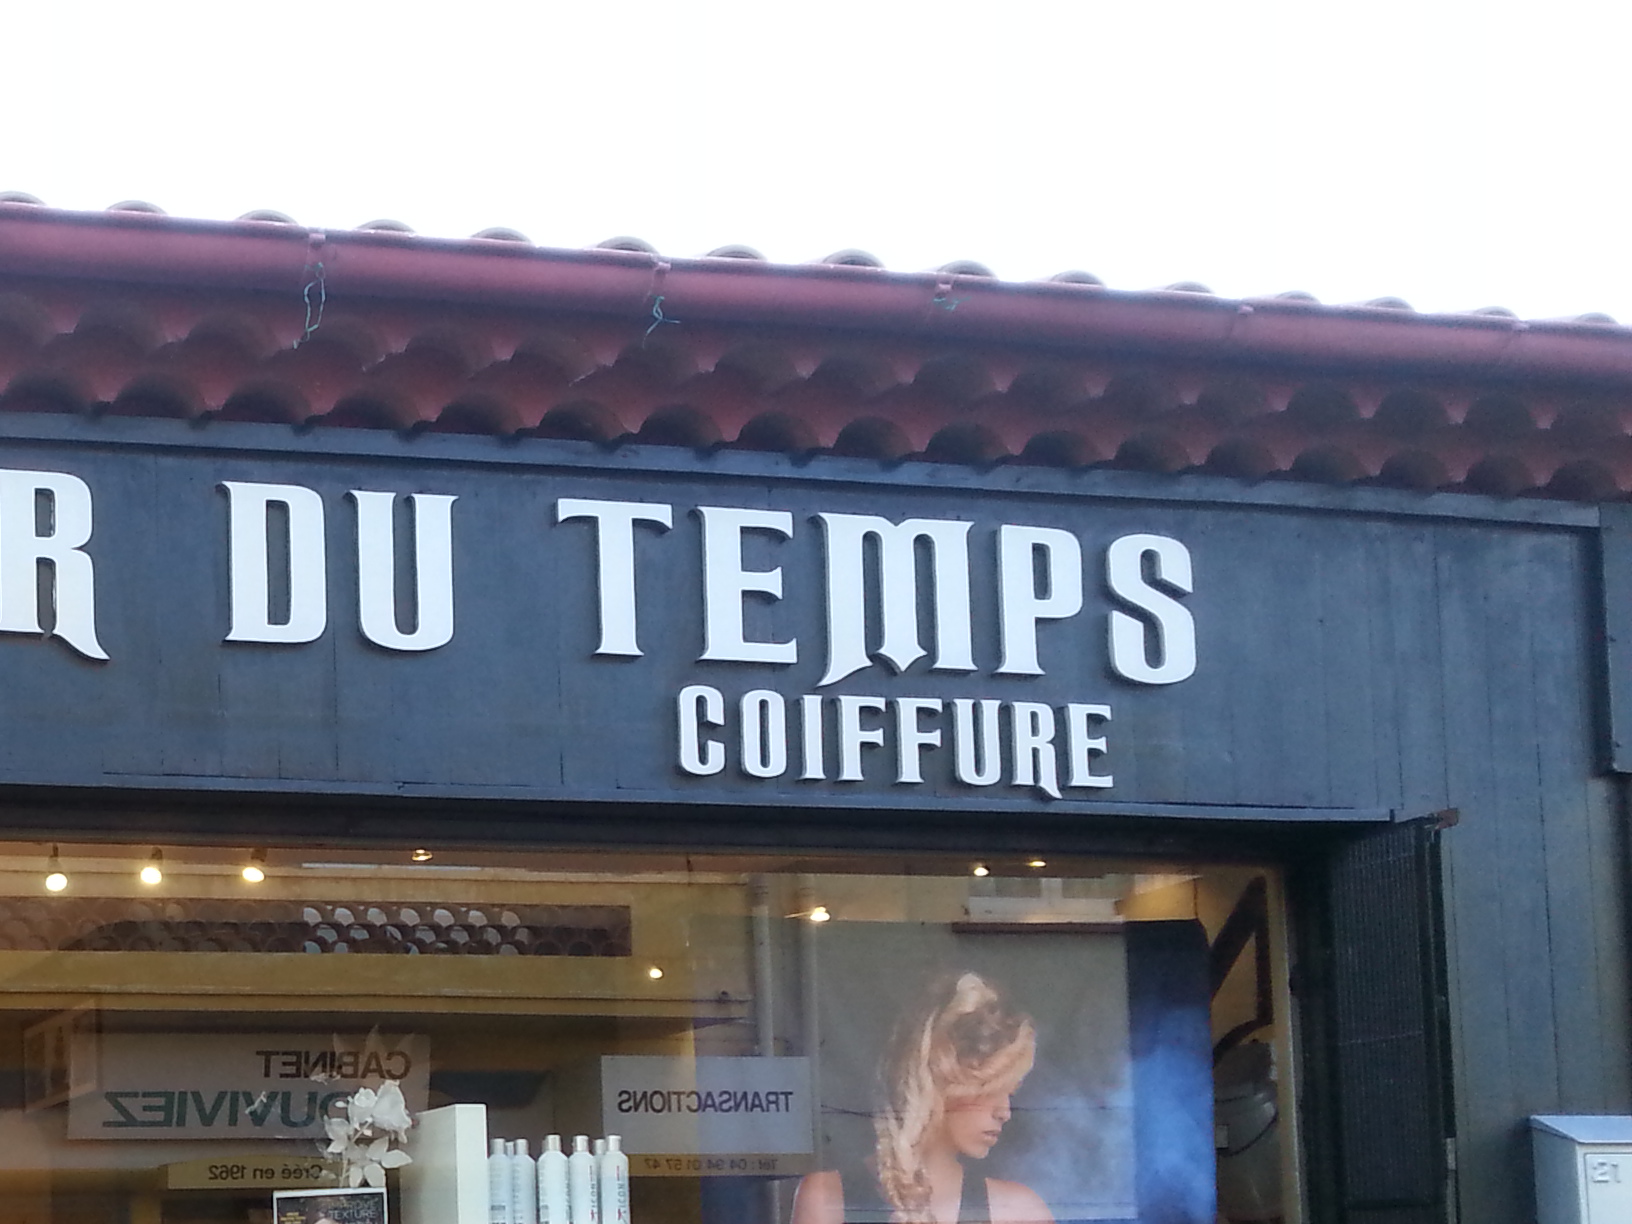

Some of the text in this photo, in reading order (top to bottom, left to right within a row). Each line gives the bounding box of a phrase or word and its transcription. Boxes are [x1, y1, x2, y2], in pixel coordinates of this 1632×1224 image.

[217, 480, 458, 652] DU
[556, 497, 1196, 687] TEMPS
[675, 684, 1114, 799] COIFFURE
